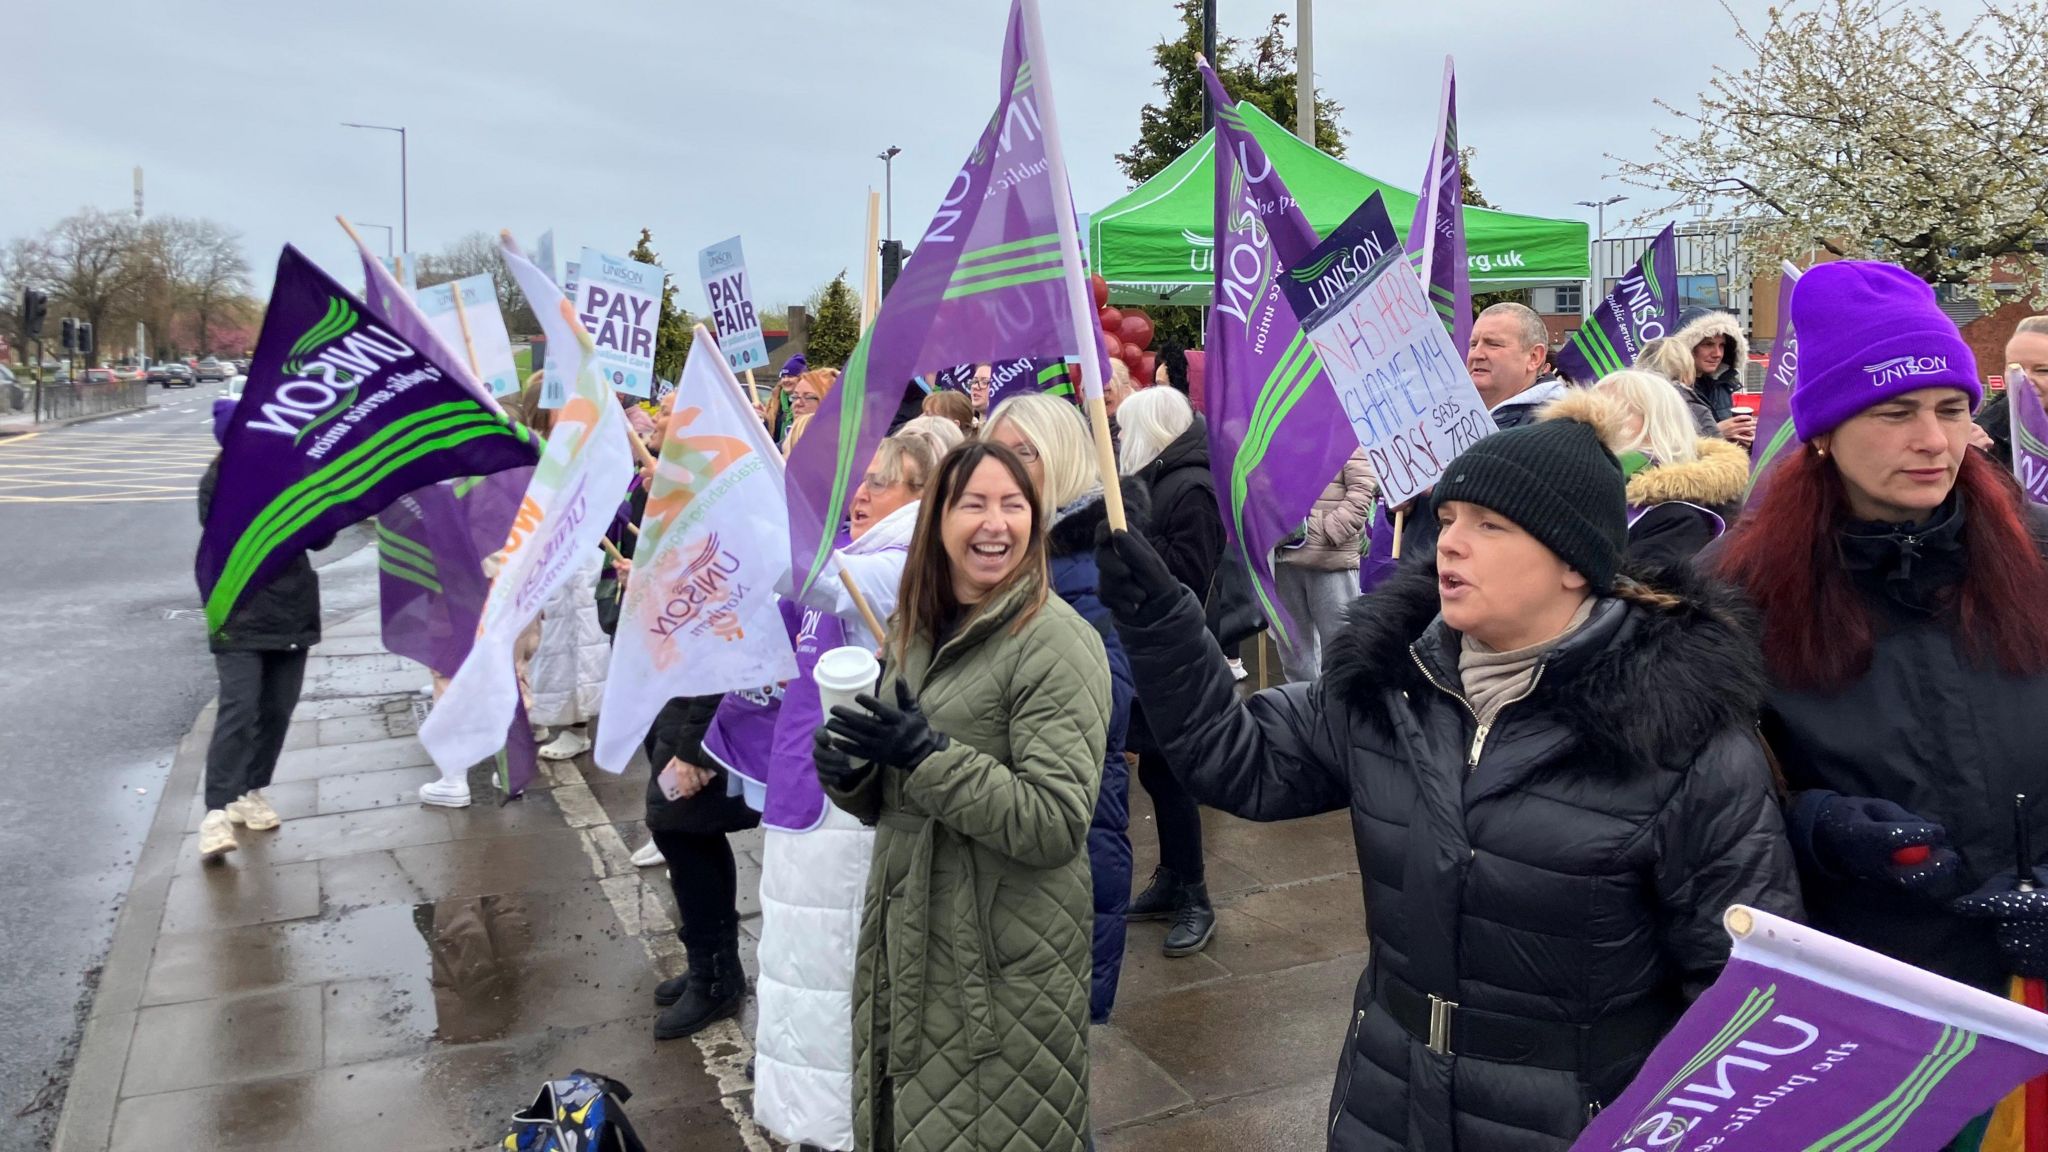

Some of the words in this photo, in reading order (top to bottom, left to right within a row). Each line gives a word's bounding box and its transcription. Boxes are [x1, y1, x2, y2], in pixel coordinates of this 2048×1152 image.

[602, 263, 644, 283] UNISON
[1308, 230, 1384, 309] UNISON
[1467, 250, 1525, 272] rg.uk
[586, 285, 652, 327] PAY
[708, 272, 744, 310] PAY
[580, 313, 652, 358] FAIR
[713, 300, 757, 337] FAIR
[1313, 303, 1386, 384] NHS
[1369, 262, 1429, 343] HERO
[1606, 294, 1625, 325] public
[1619, 321, 1635, 353] service
[1345, 352, 1427, 447] SHAME
[1410, 328, 1456, 405] MY
[1873, 355, 1947, 387] UNISON
[1432, 396, 1461, 428] SAYS
[1369, 421, 1445, 500] PURSE
[1444, 409, 1489, 458] ZERO
